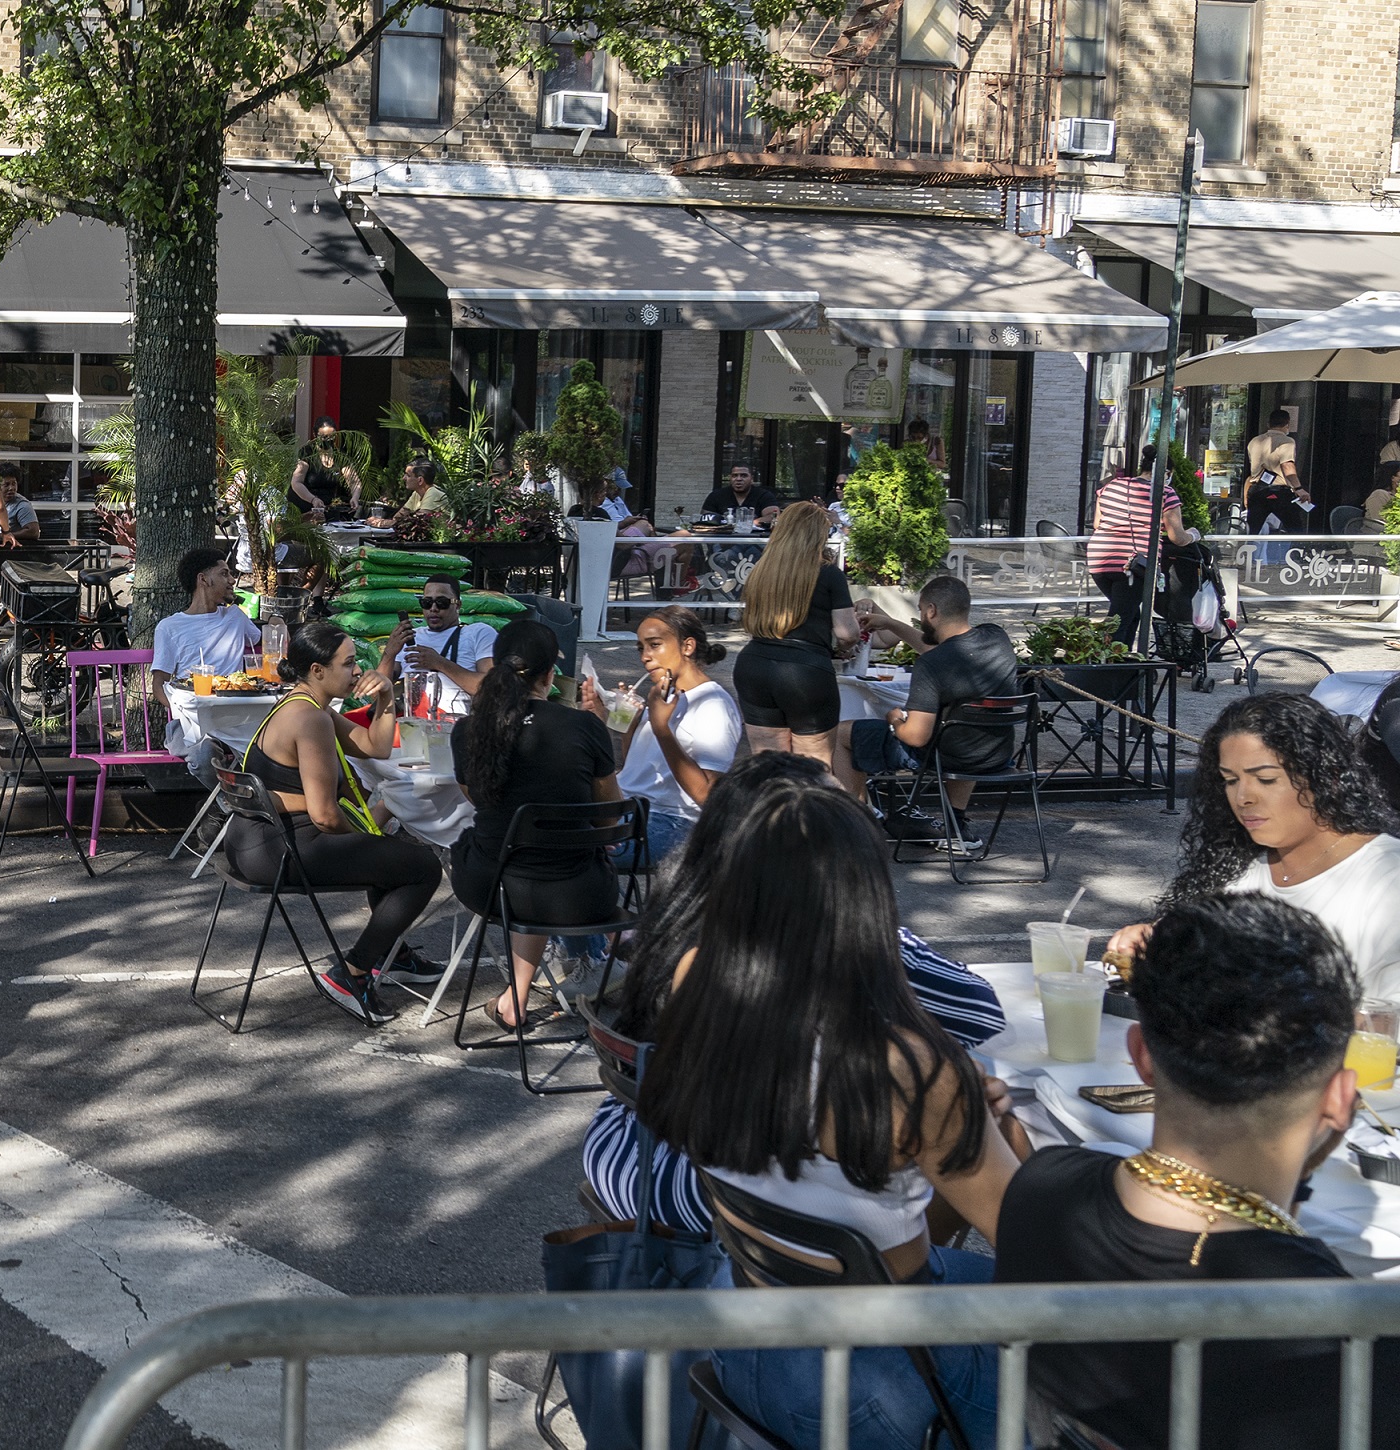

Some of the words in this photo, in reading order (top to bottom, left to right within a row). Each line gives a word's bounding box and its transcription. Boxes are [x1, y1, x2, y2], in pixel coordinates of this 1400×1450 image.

[461, 306, 486, 320] 233
[591, 306, 609, 323] IL
[956, 327, 974, 344] IL
[653, 547, 692, 589] IL
[1236, 544, 1271, 585] IL
